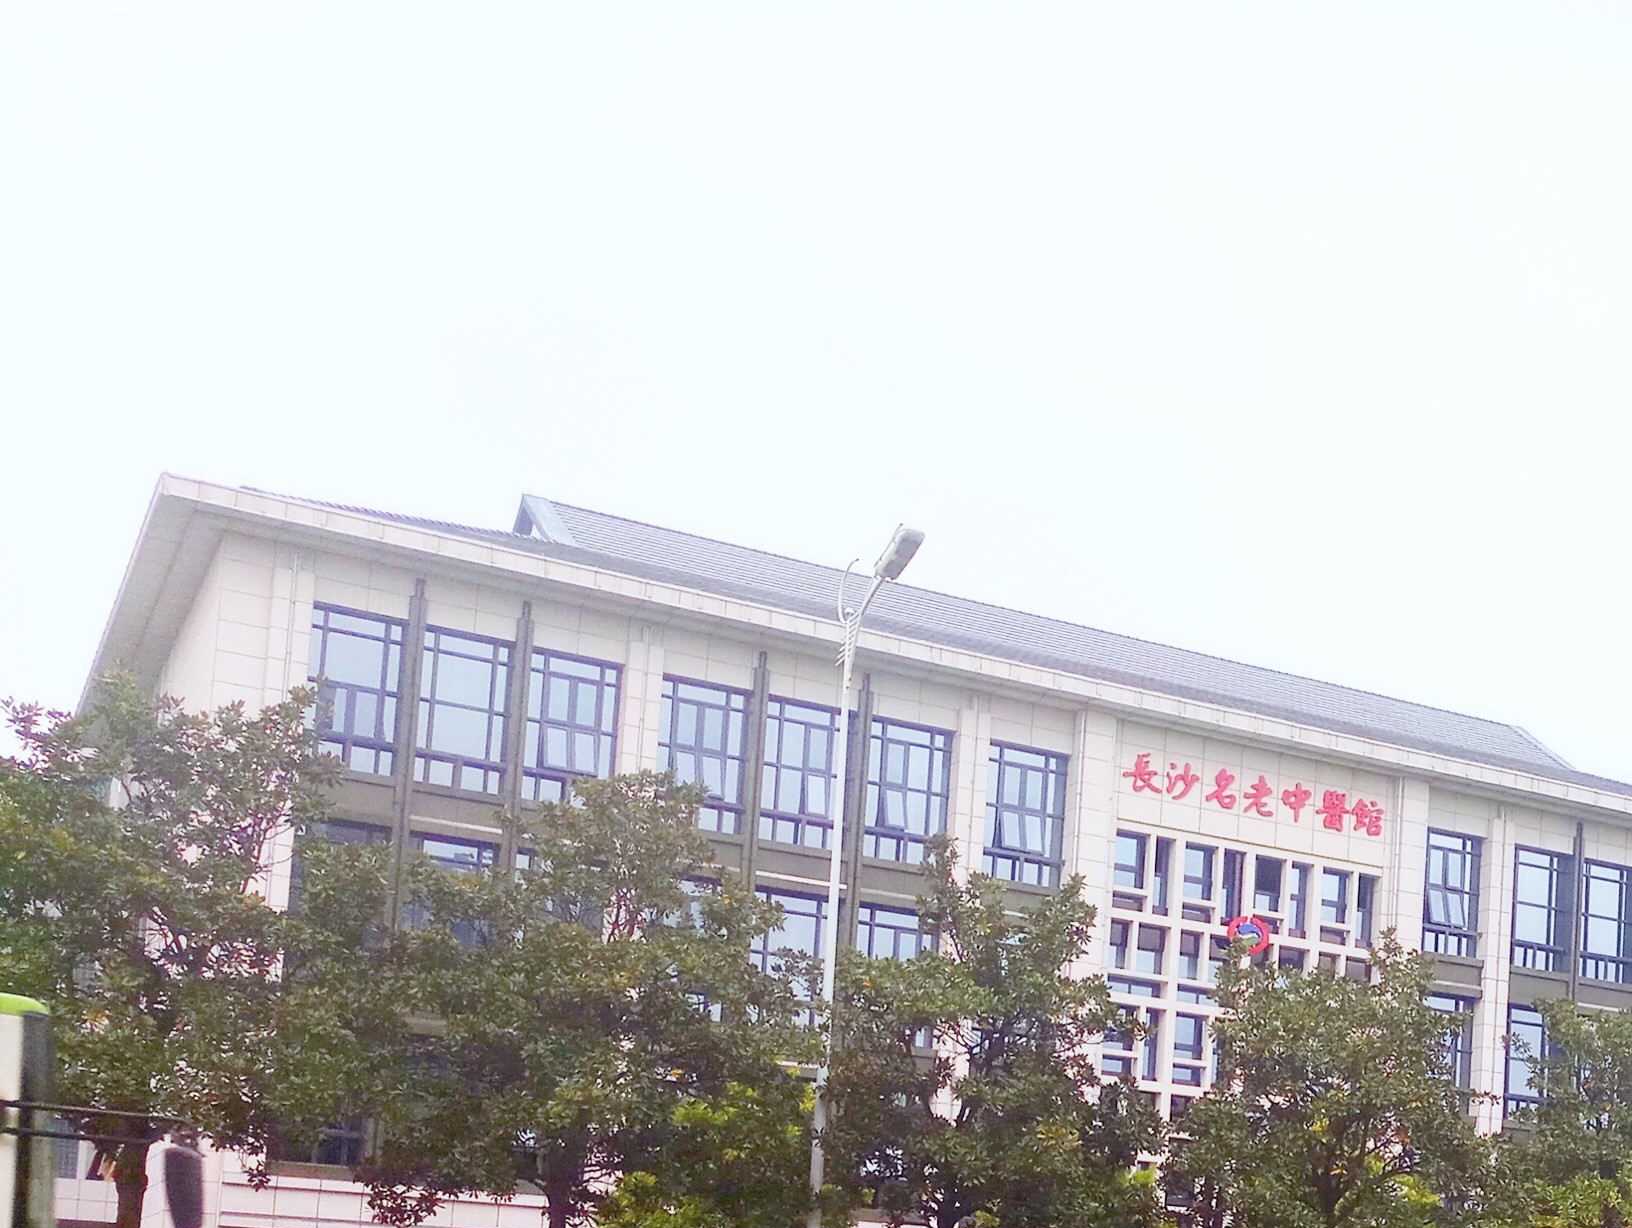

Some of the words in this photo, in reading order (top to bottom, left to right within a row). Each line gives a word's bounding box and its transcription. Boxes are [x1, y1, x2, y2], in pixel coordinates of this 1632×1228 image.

[1123, 752, 1385, 836] 長沙名老中醫館
